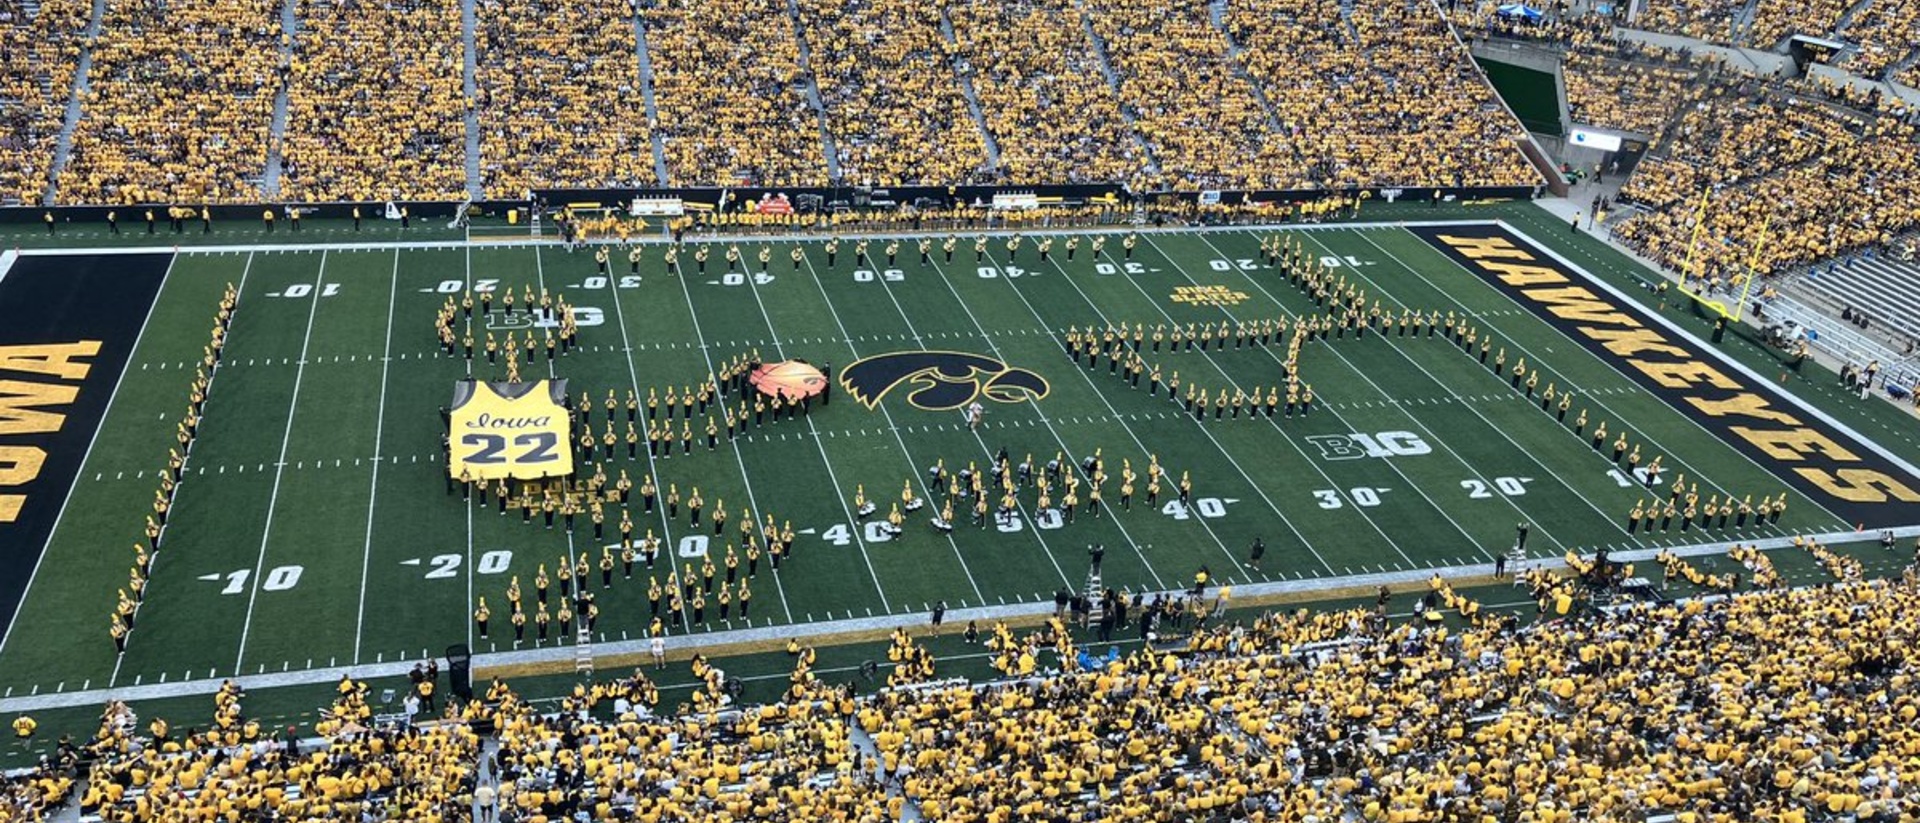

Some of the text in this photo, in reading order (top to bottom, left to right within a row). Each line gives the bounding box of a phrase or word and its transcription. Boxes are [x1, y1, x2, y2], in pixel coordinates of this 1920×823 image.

[1095, 262, 1145, 275] 30
[1209, 258, 1258, 271] 20
[1319, 255, 1362, 267] 10
[721, 272, 775, 286] 40
[853, 269, 905, 282] 50
[976, 265, 1025, 279] 40
[284, 283, 341, 298] 10
[437, 278, 500, 293] 20
[583, 275, 642, 290] 30
[1436, 234, 1920, 502] HAWKEYES
[465, 412, 551, 428] Iowa
[0, 340, 103, 522] WA
[461, 432, 559, 464] 22
[1606, 467, 1663, 487] 10
[1460, 477, 1526, 498] 20
[1312, 487, 1381, 509] 30
[1162, 498, 1227, 520] 40
[994, 508, 1063, 532] 50
[822, 521, 892, 545] 40
[630, 535, 709, 562] 30
[424, 551, 512, 578] 20
[220, 564, 303, 595] 10
